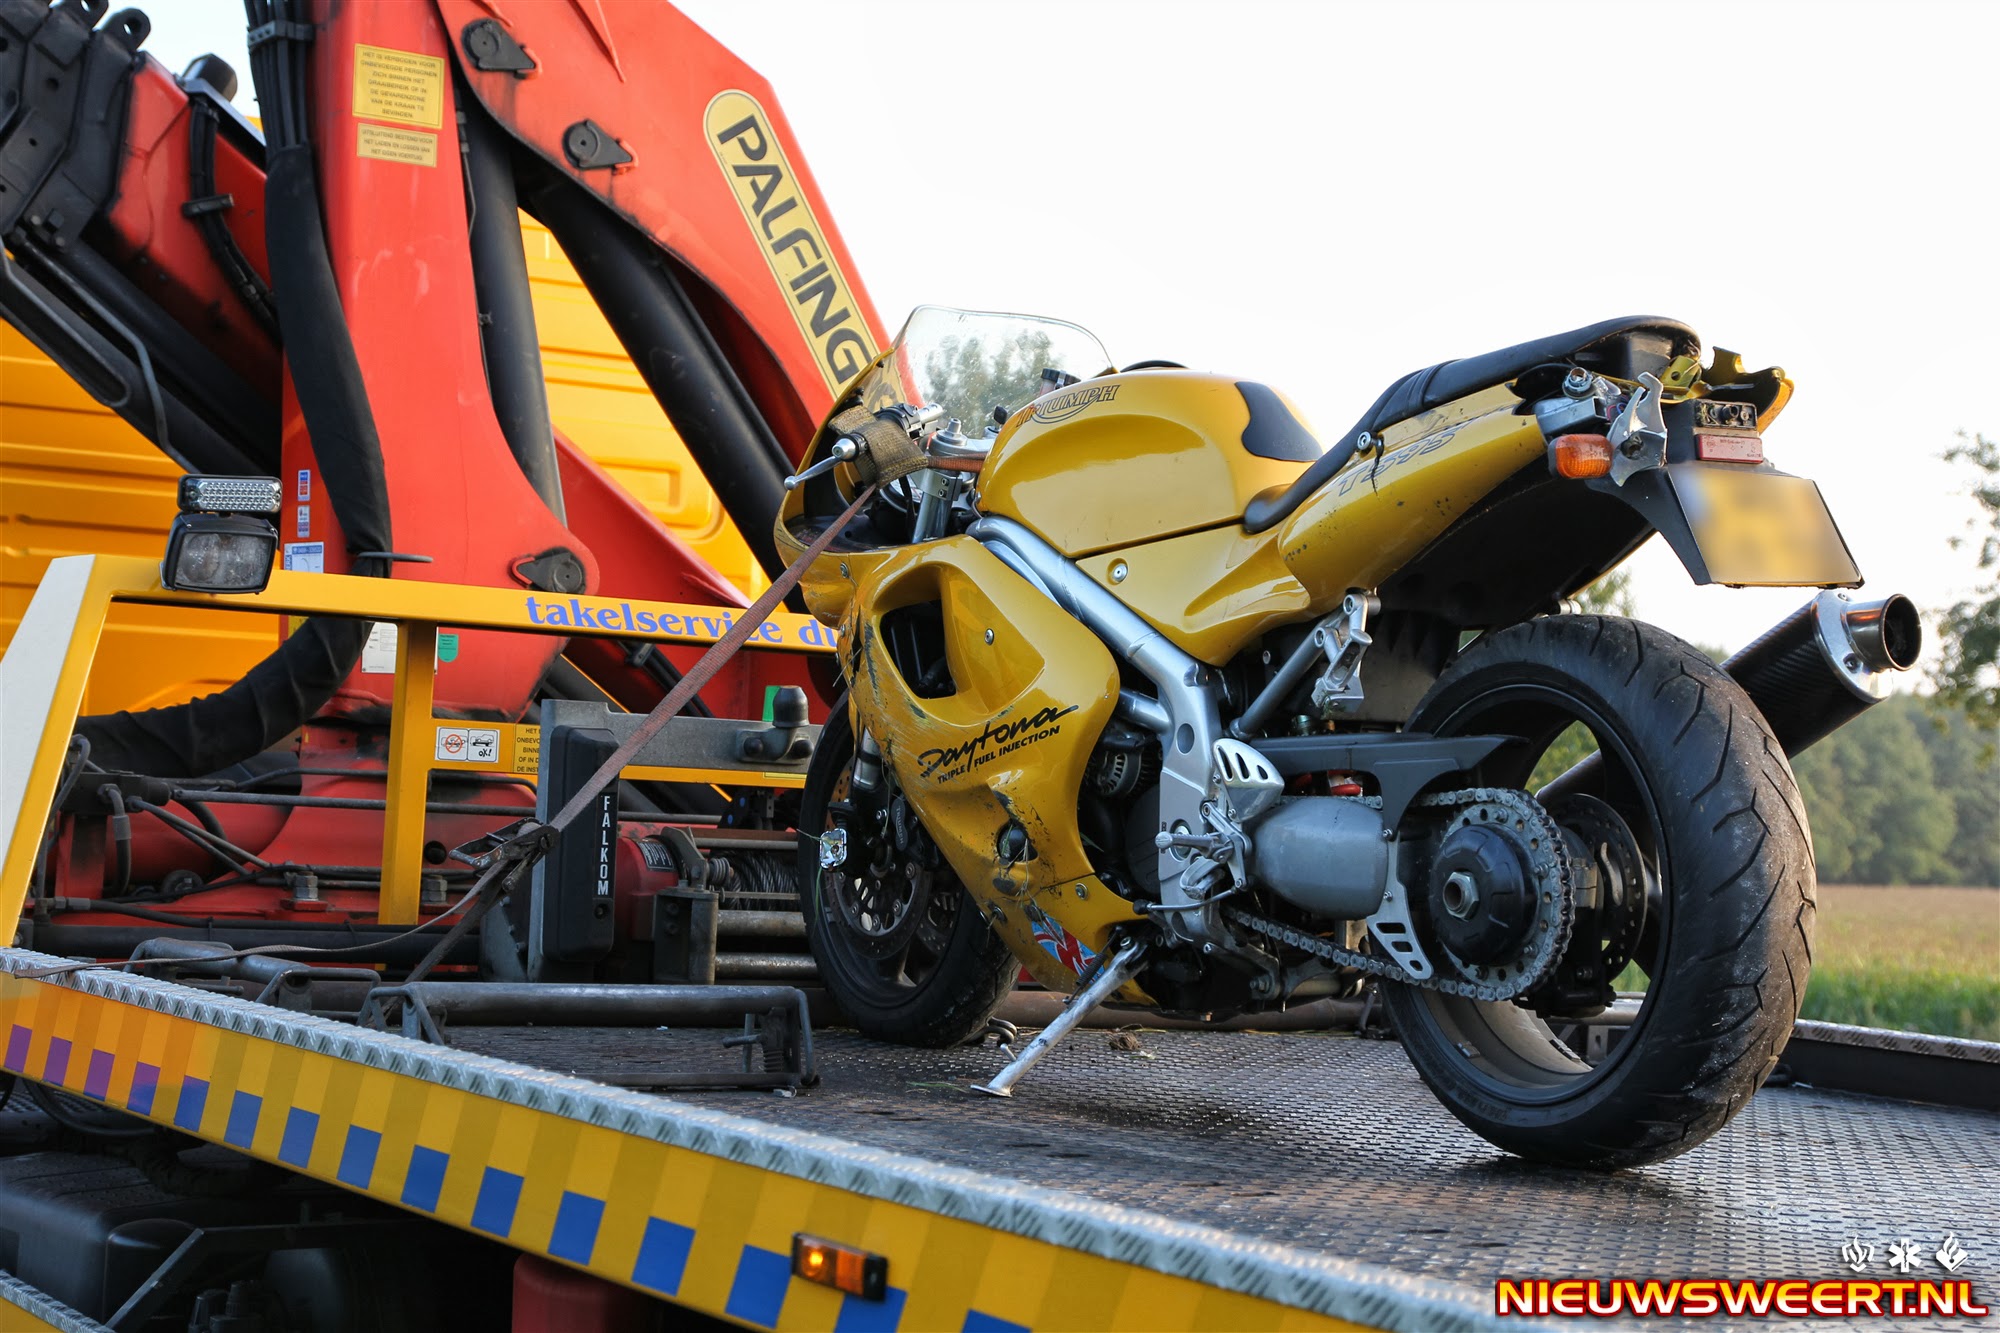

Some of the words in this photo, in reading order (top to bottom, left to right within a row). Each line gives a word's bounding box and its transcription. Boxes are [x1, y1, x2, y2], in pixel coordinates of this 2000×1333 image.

[1016, 384, 1120, 427] TRIUMPH
[917, 705, 1079, 778] Daytona
[937, 764, 966, 784] TRIPLE
[974, 752, 996, 768] FUEL
[998, 725, 1061, 757] INJECTION
[597, 796, 611, 895] FALKOM
